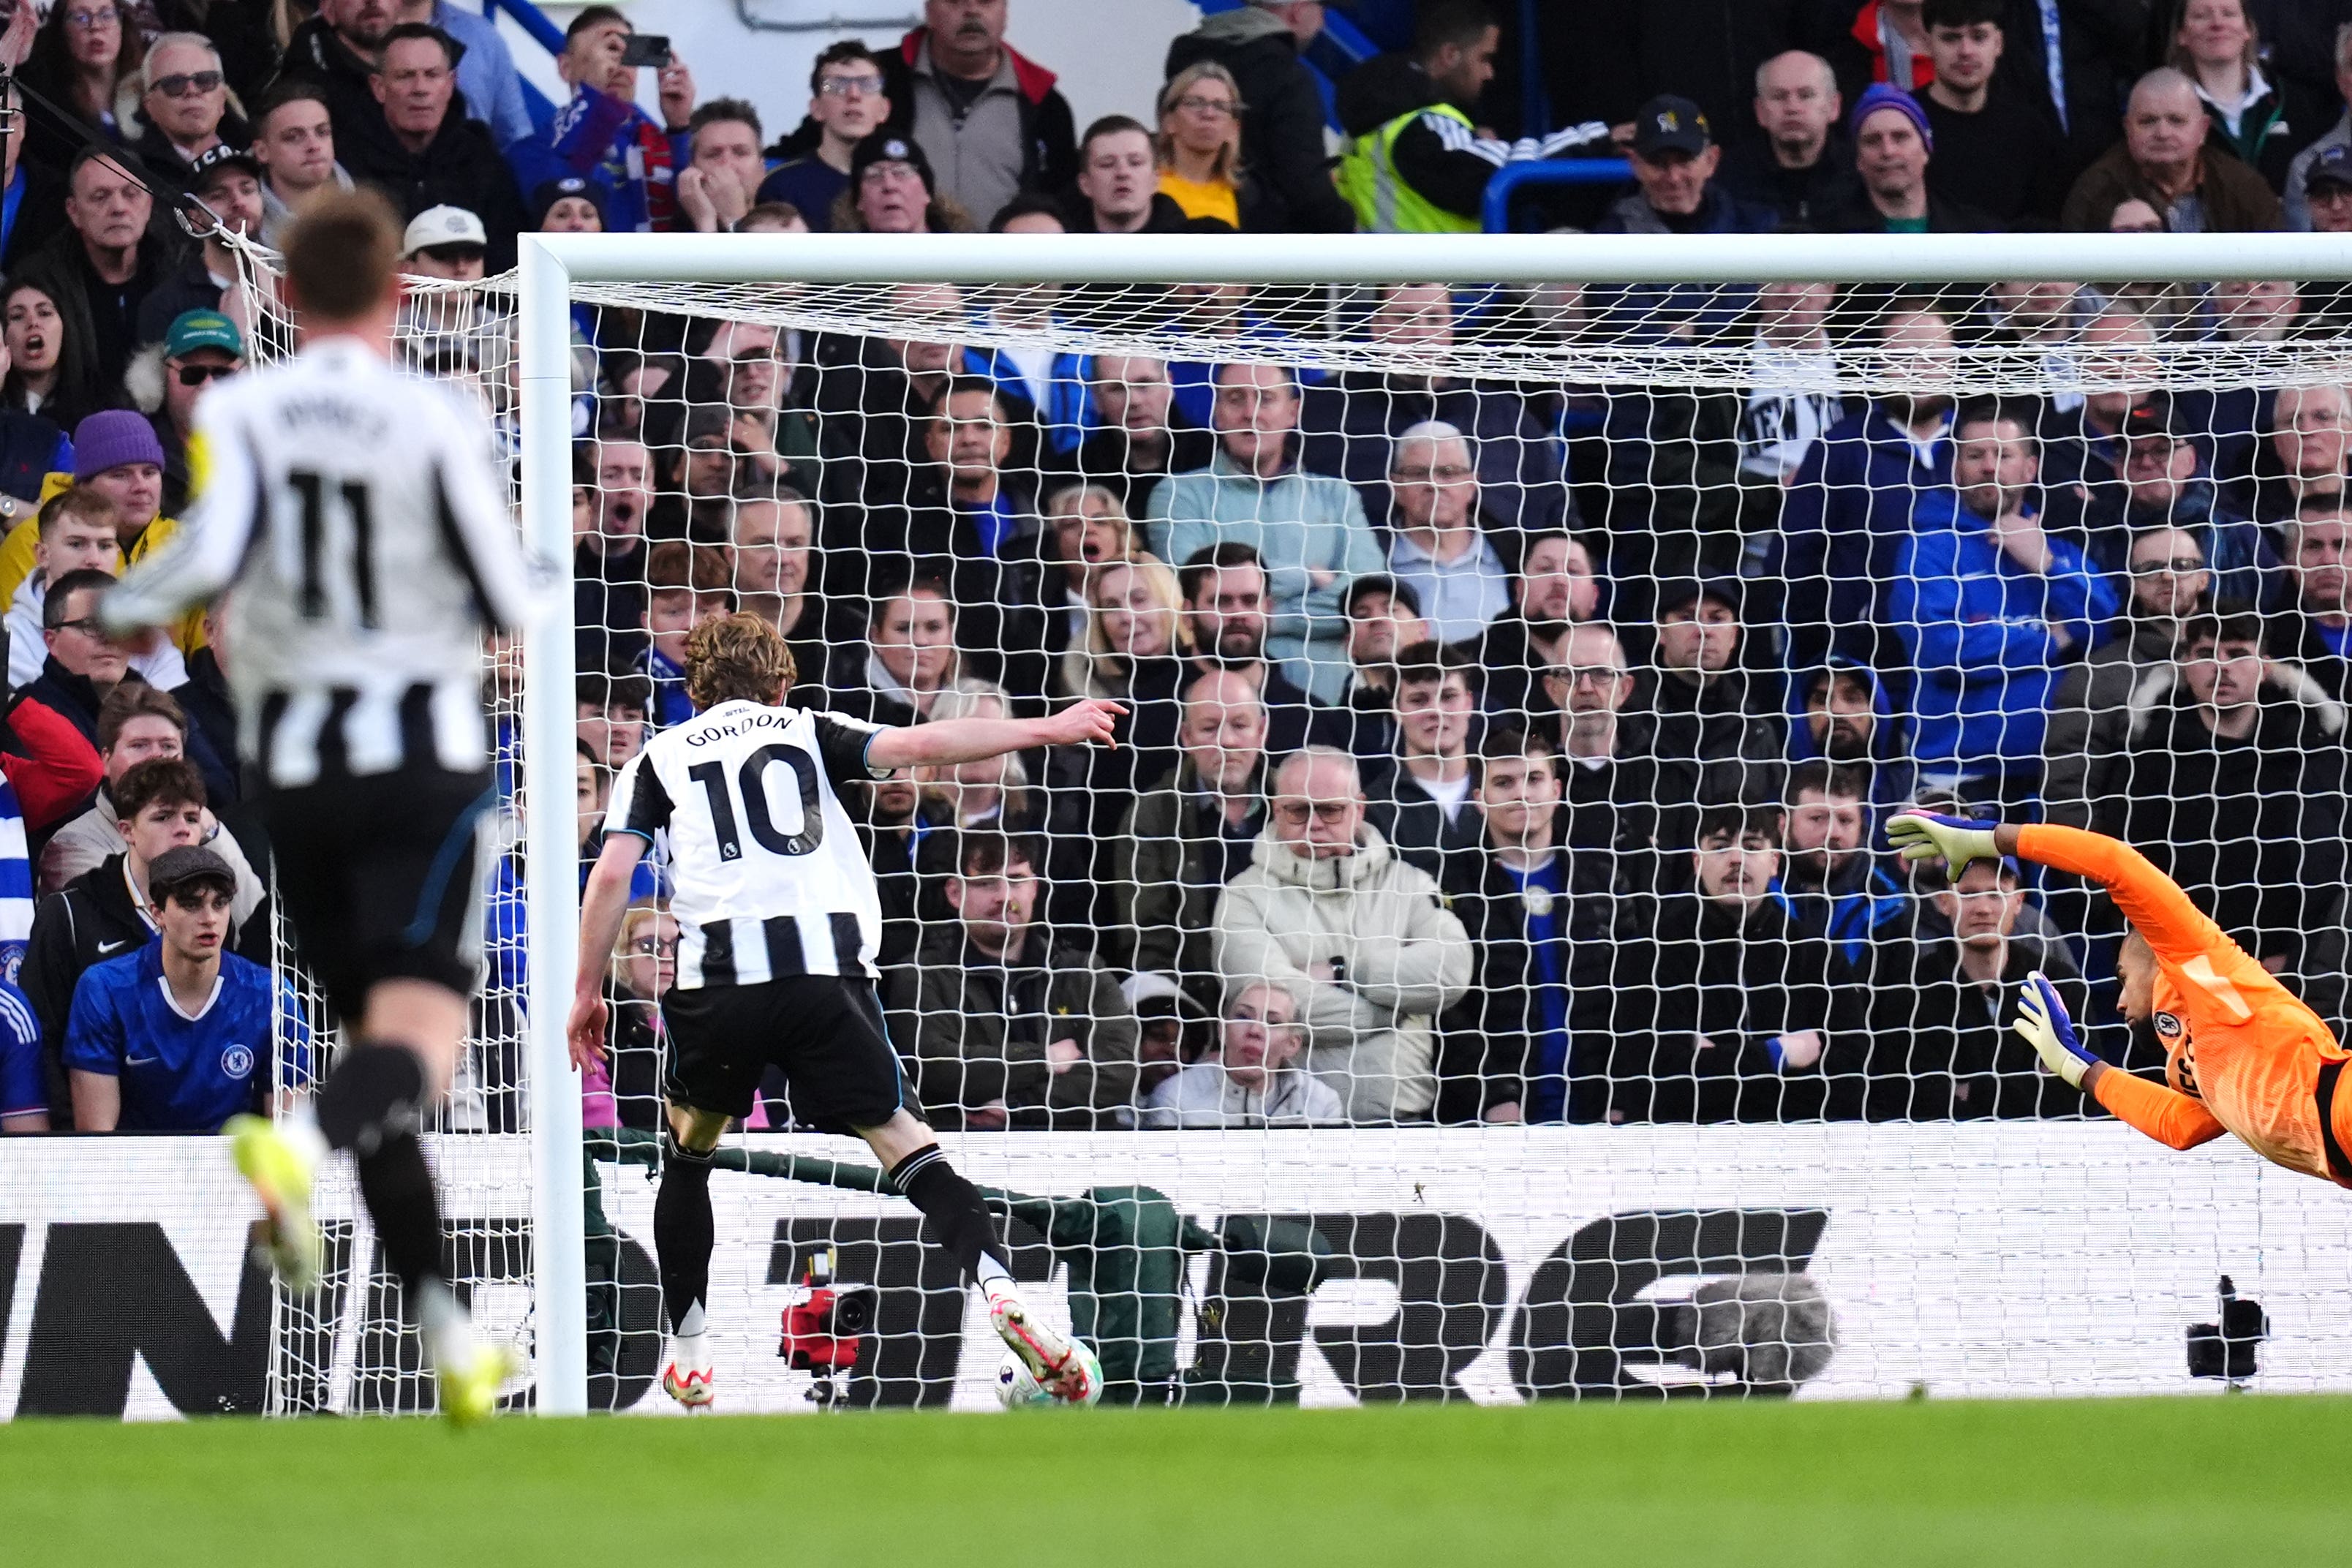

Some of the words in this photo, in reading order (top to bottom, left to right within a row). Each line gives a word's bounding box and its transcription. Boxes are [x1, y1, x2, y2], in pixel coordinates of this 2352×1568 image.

[287, 467, 380, 629] 11
[686, 714, 793, 747] GORDON
[687, 743, 823, 863] 10
